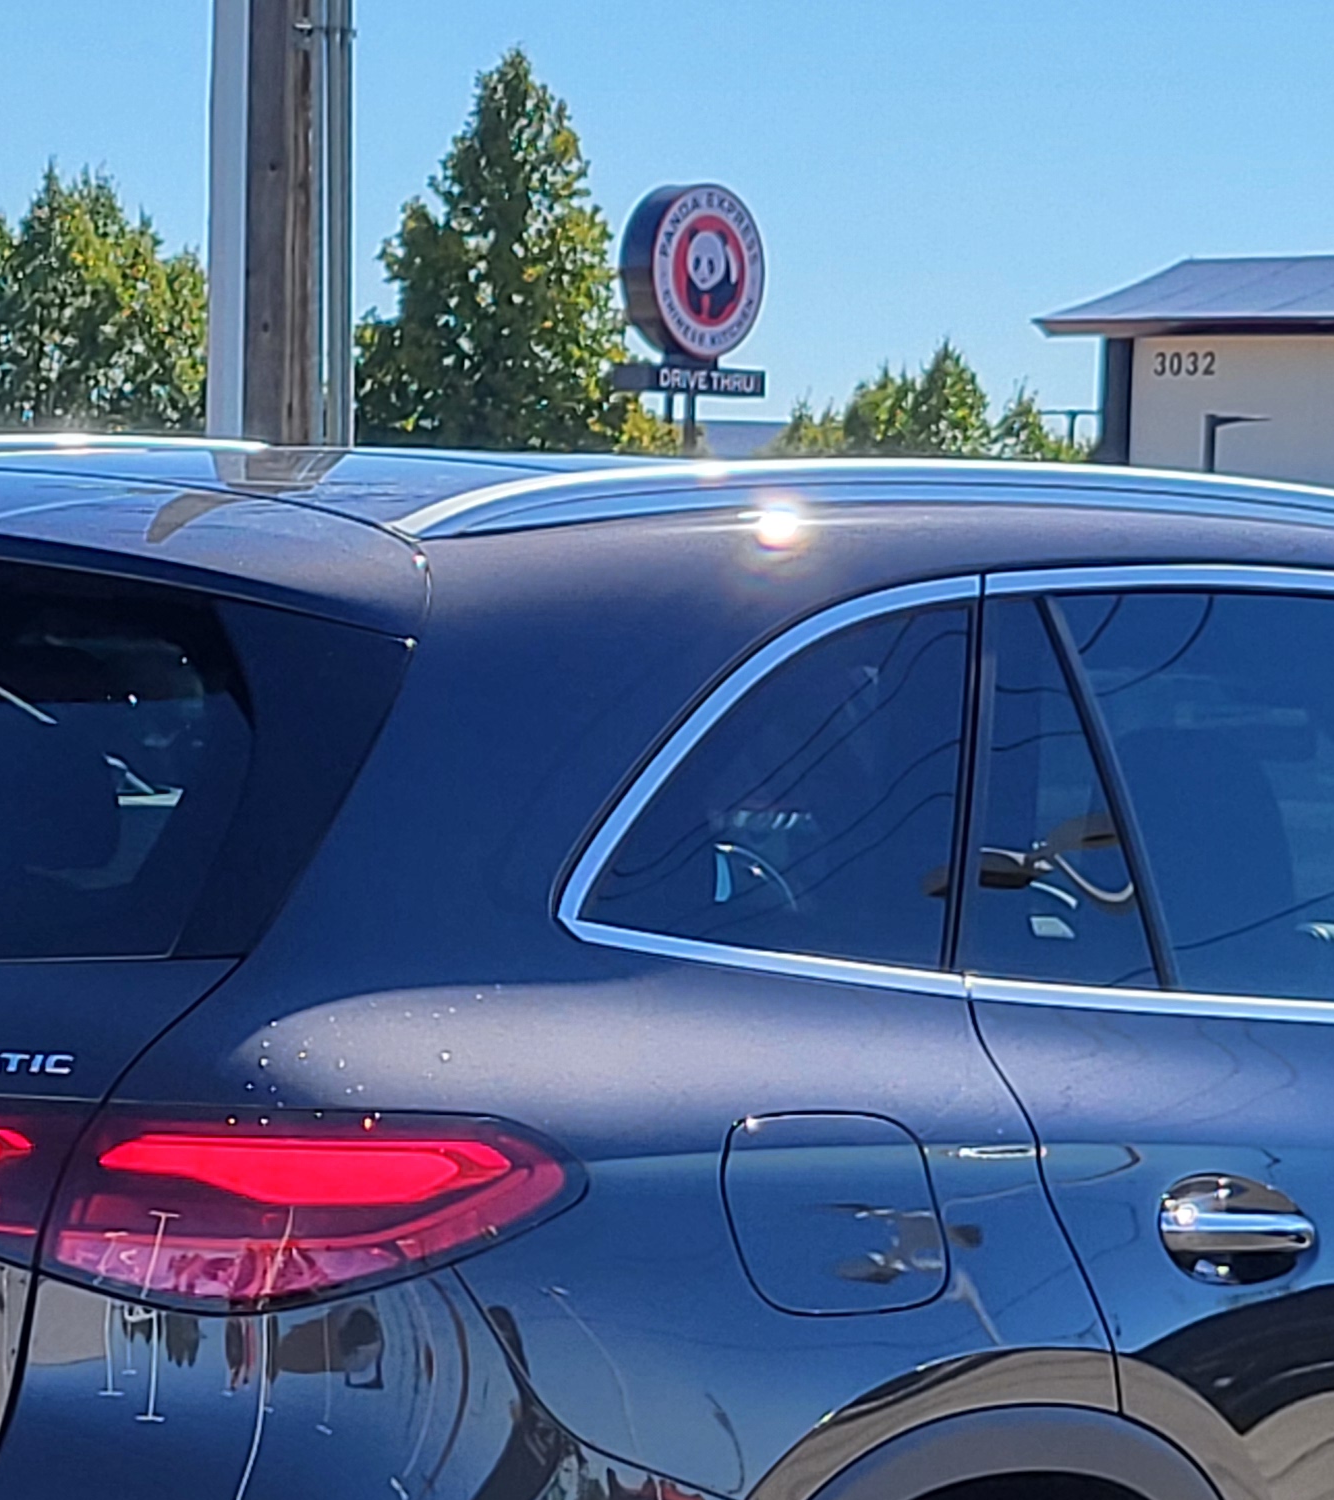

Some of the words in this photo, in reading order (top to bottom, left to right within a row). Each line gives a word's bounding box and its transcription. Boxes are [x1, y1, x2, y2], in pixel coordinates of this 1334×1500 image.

[660, 197, 700, 257] PANDA
[706, 192, 758, 266] EXPRESS
[709, 297, 753, 346] KITCHEN
[658, 368, 708, 390] DRIVE
[711, 371, 755, 392] THRU
[1153, 351, 1216, 377] 3032
